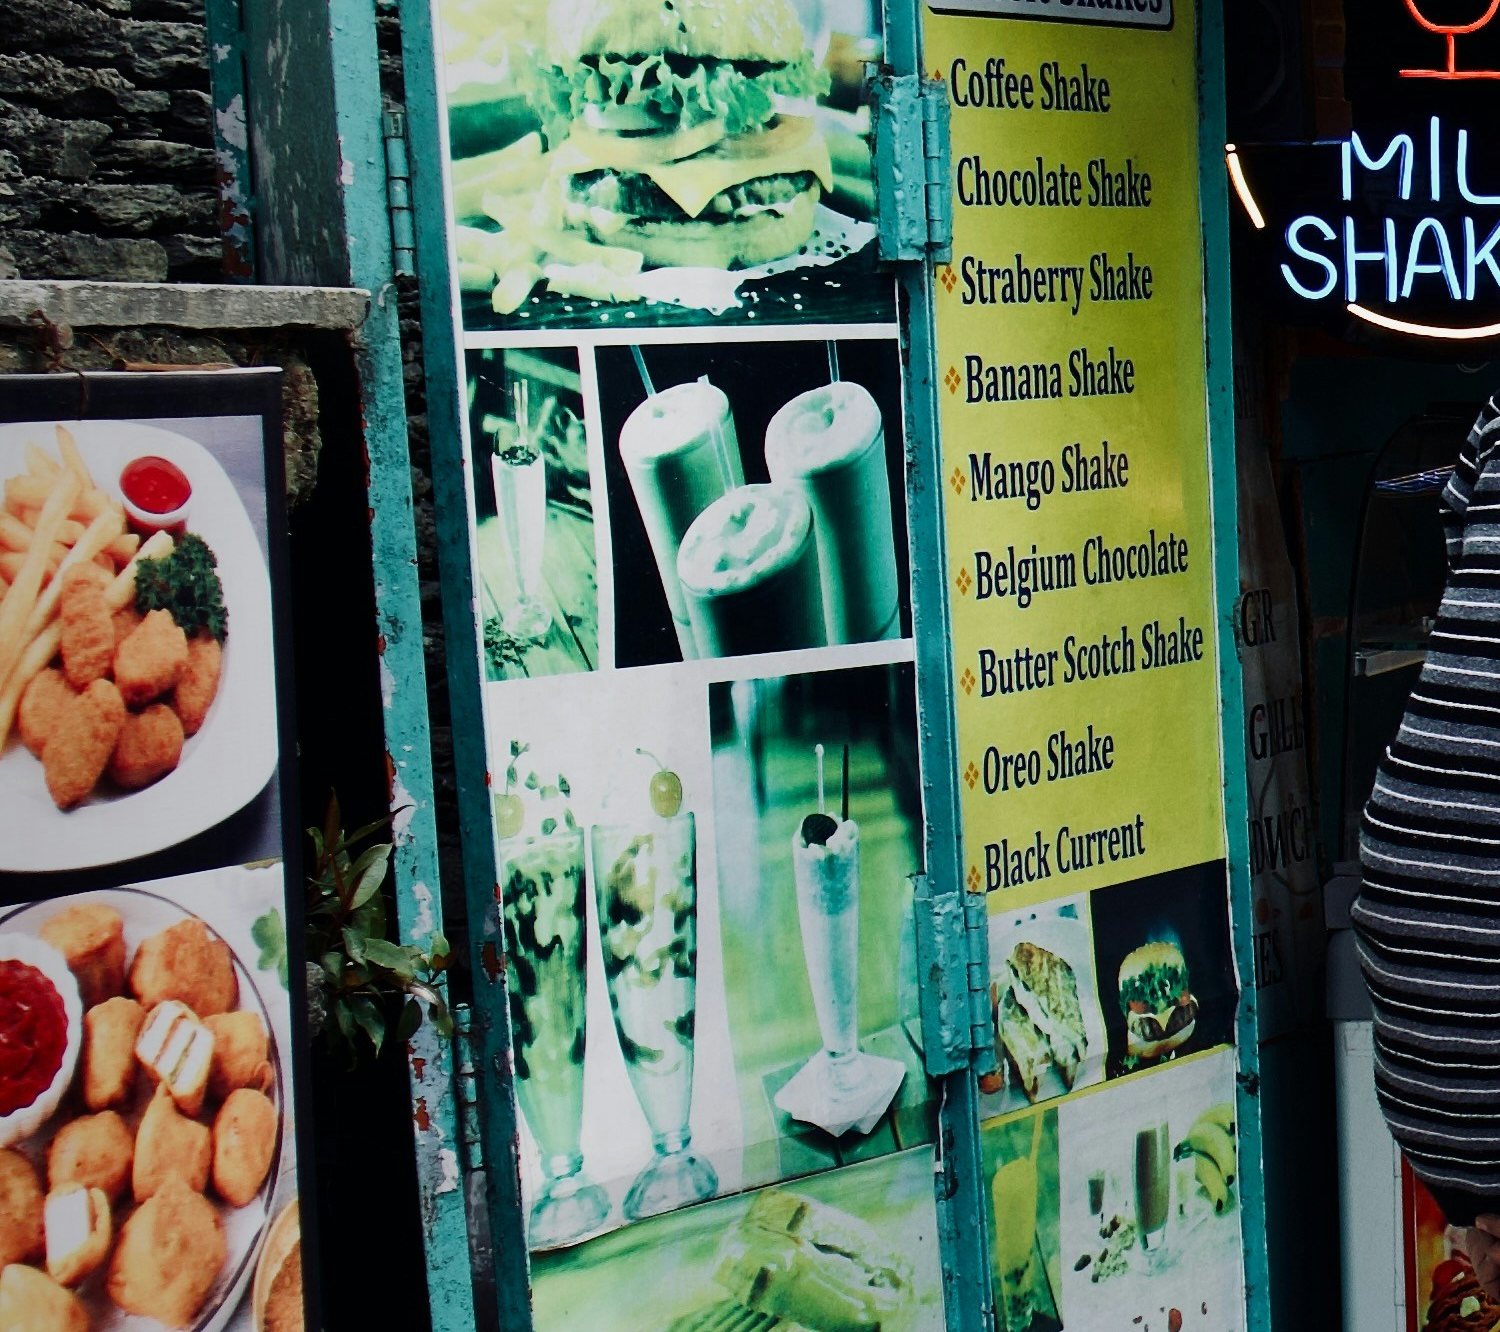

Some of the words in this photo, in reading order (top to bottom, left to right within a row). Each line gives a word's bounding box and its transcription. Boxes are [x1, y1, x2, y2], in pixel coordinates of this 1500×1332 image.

[950, 57, 1035, 110] Coffee
[1039, 61, 1112, 114] Shake
[957, 155, 1083, 207] Chocolate
[1087, 156, 1154, 208] Shake
[961, 253, 1085, 316] Straberry
[1089, 252, 1154, 302] Shake
[964, 355, 1063, 404] Banana
[1068, 346, 1135, 398] Shake
[968, 452, 1055, 511] Mango
[1061, 440, 1129, 493] Shake
[974, 544, 1077, 609] Belgium
[1082, 529, 1189, 586] Chocolate
[978, 647, 1059, 698] Butter
[1063, 629, 1136, 682] Scotch
[1141, 616, 1204, 670] Shake
[983, 746, 1041, 795] Oreo
[1047, 724, 1114, 782] Shake
[984, 832, 1052, 893] Black
[1056, 813, 1146, 870] Current
